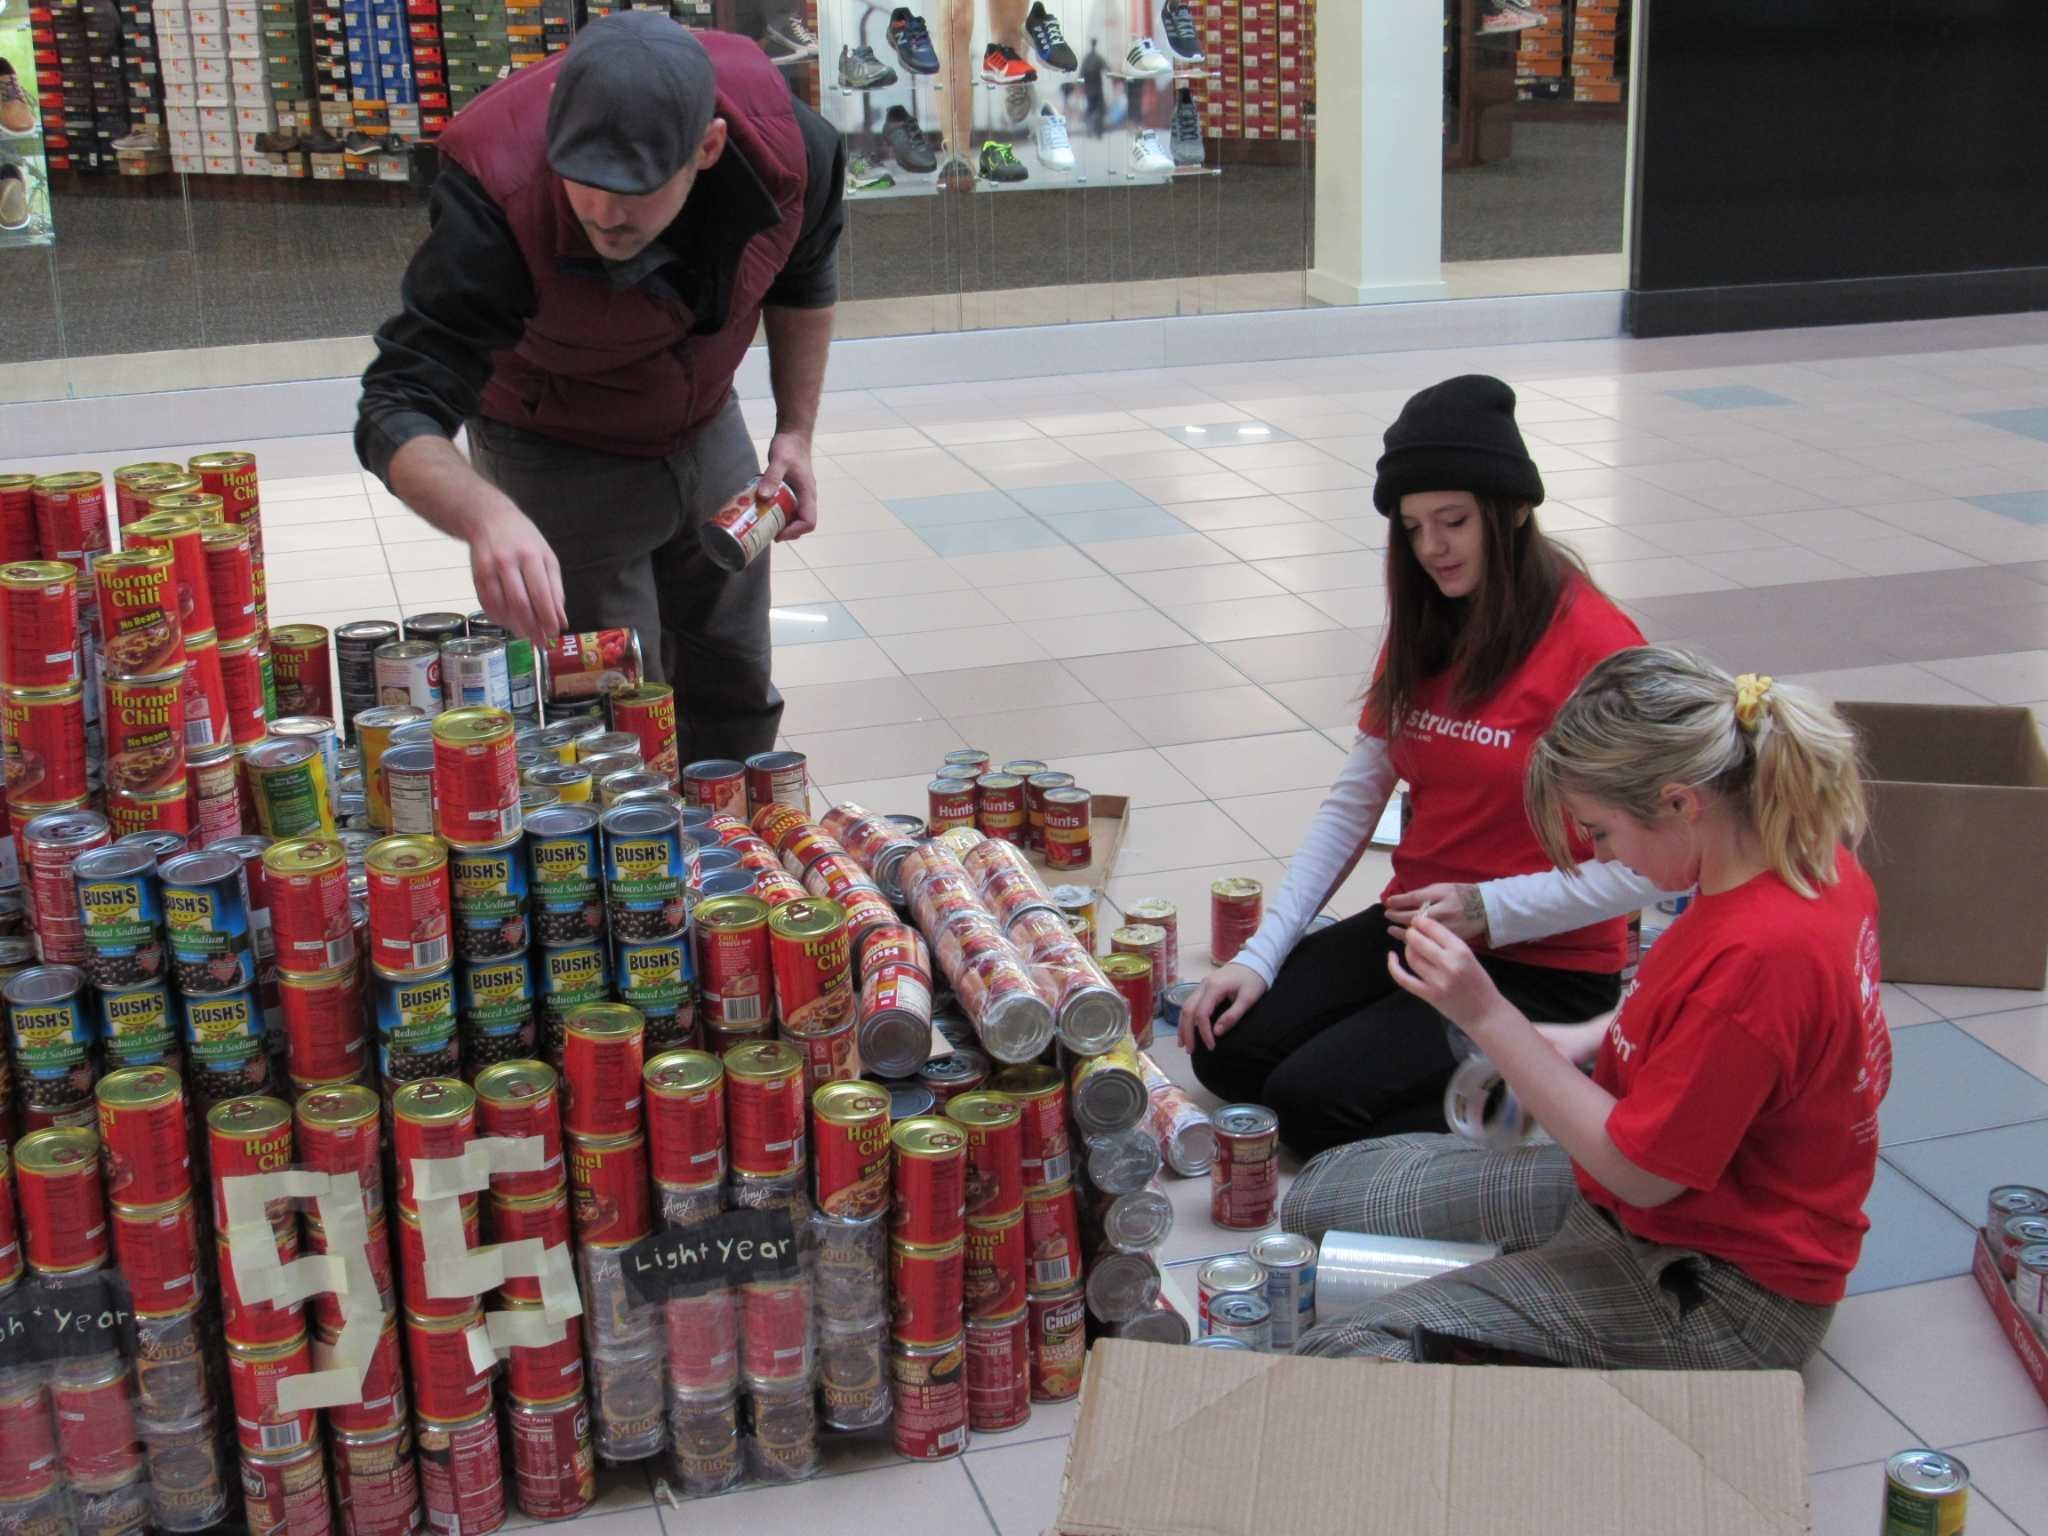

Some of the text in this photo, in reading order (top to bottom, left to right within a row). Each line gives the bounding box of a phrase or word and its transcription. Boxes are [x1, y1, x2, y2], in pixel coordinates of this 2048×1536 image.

[101, 566, 168, 590] Hormel
[111, 586, 161, 607] Chili
[111, 687, 178, 708] Hormel
[121, 707, 169, 726] Chili
[1406, 709, 1513, 749] struction
[535, 844, 587, 864] BUSH'S
[615, 844, 667, 863] BUSH'S
[453, 861, 506, 880] BUSH'S
[83, 887, 136, 907] BUSH'S
[551, 952, 601, 975] BUSH'S
[629, 950, 680, 971] BUSH'S
[472, 967, 524, 990] BUSH'S
[109, 994, 164, 1018] BUSH'S
[400, 983, 450, 1009] BUSH'S
[16, 1010, 70, 1032] BUSH'S
[191, 1003, 247, 1025] BUSH'S
[635, 1243, 712, 1273] Light
[1045, 1305, 1084, 1330] CHUNK
